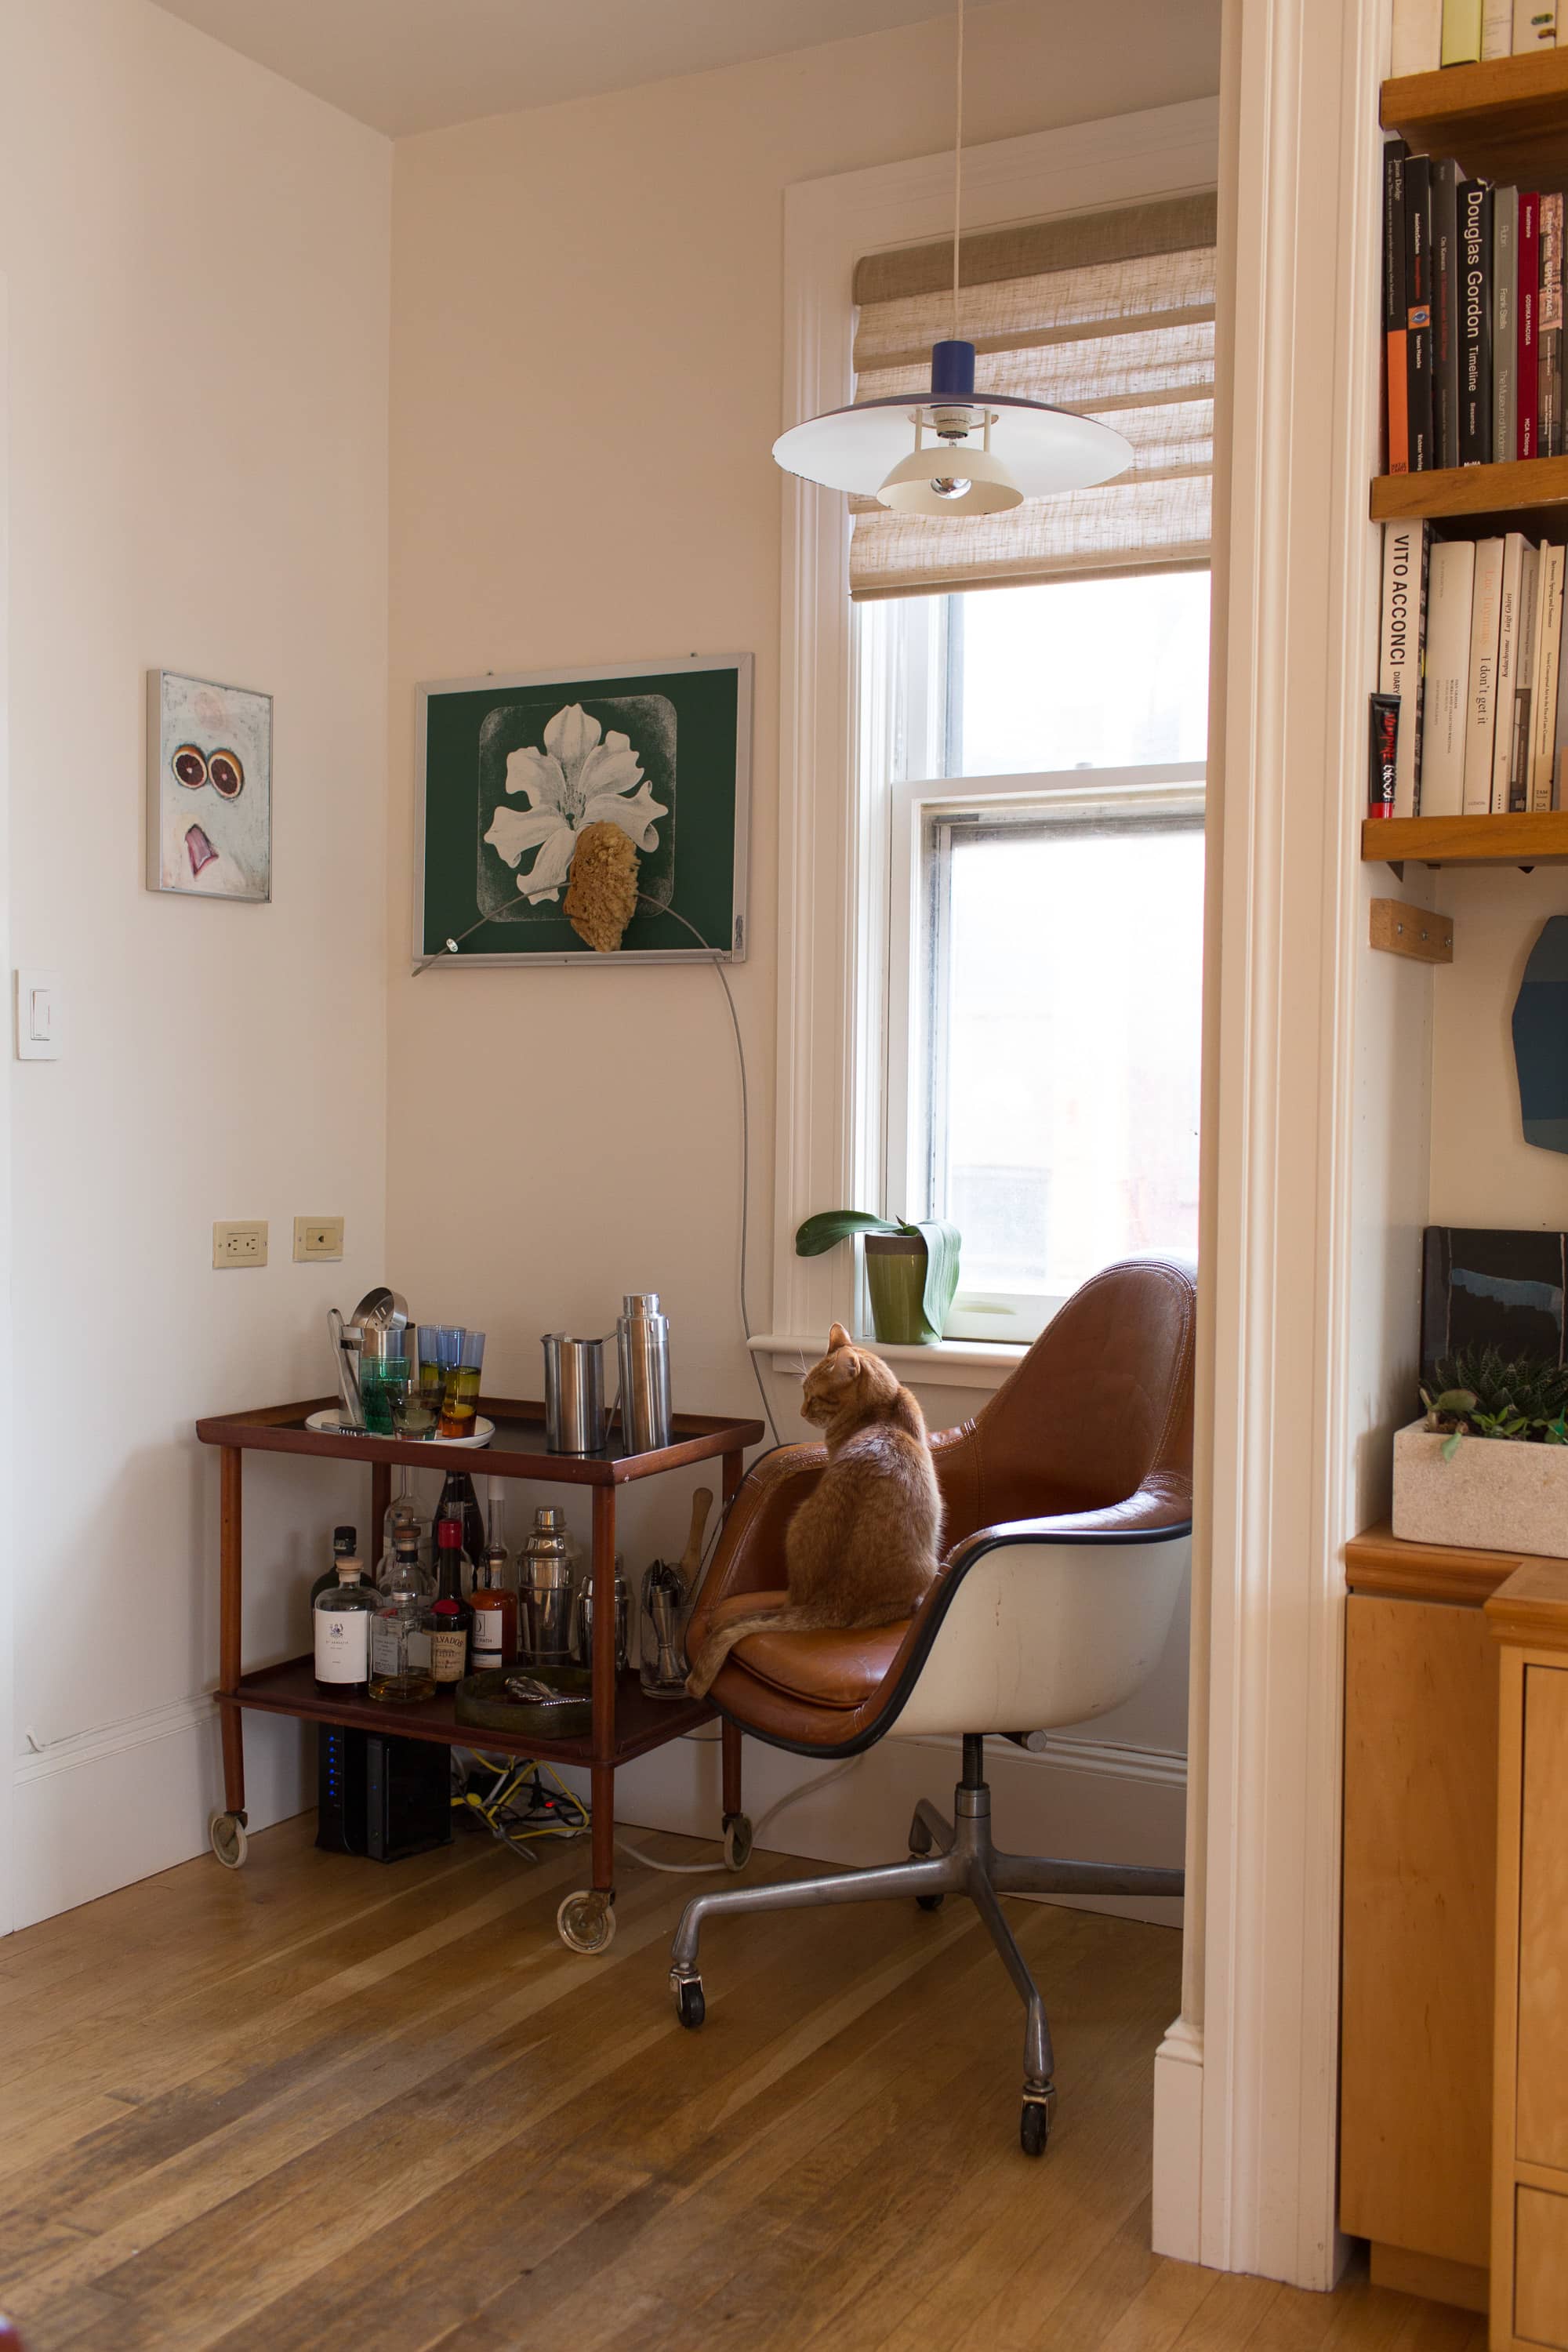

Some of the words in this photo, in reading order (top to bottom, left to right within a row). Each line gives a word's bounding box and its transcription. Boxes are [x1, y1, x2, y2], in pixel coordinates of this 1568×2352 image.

[1393, 159, 1402, 177] Jason
[1464, 191, 1483, 265] Douglas
[1500, 225, 1509, 248] Rubin
[1441, 237, 1447, 246] On
[1467, 271, 1483, 337] Gordon
[1499, 289, 1508, 308] Frank
[1468, 345, 1479, 392] Timeline
[1498, 370, 1508, 384] The
[1498, 384, 1508, 419] Museum
[1497, 426, 1507, 455] Modern
[1392, 535, 1410, 577] VITO
[1485, 571, 1494, 591] Luc
[1504, 593, 1513, 614] Ghirri
[1389, 581, 1408, 665] ACCONCI
[1480, 596, 1494, 646] Tuymans
[1504, 615, 1512, 633] Luigi
[1502, 640, 1512, 677] Kodachrome
[1392, 671, 1402, 695] DIARY
[1479, 665, 1490, 695] don't
[1475, 697, 1488, 713] get
[1477, 717, 1488, 725] it
[1383, 764, 1396, 798] blood
[436, 1635, 464, 1647] LVADOS
